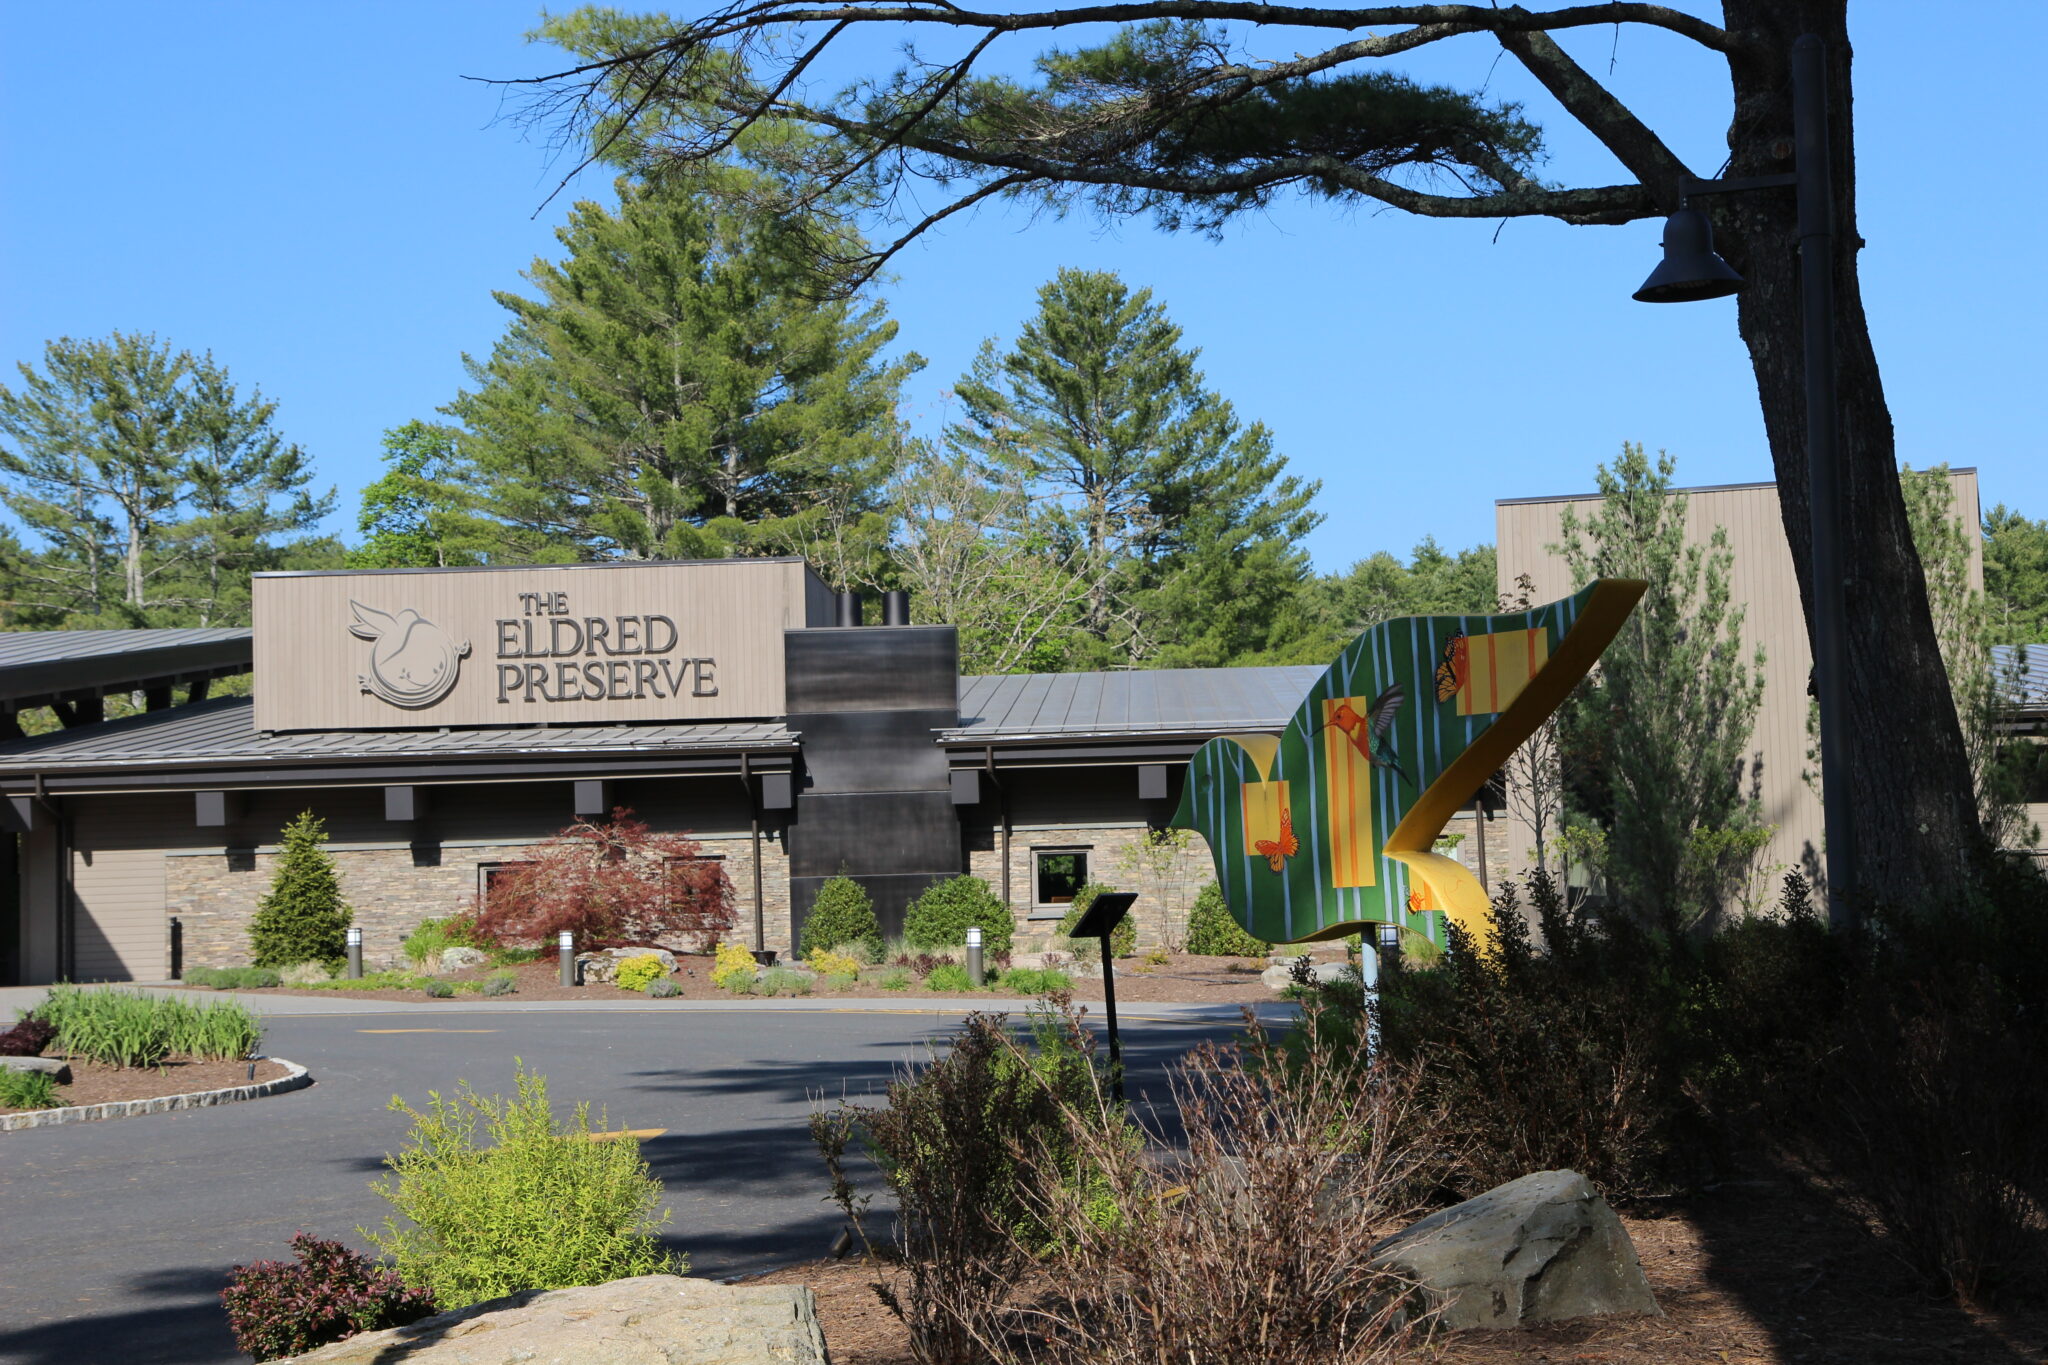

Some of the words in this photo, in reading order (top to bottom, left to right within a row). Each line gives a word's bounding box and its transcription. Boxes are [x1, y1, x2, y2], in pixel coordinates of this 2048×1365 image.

[519, 592, 569, 616] THE
[496, 615, 678, 658] ELDRED
[496, 658, 718, 703] PRESERVE
